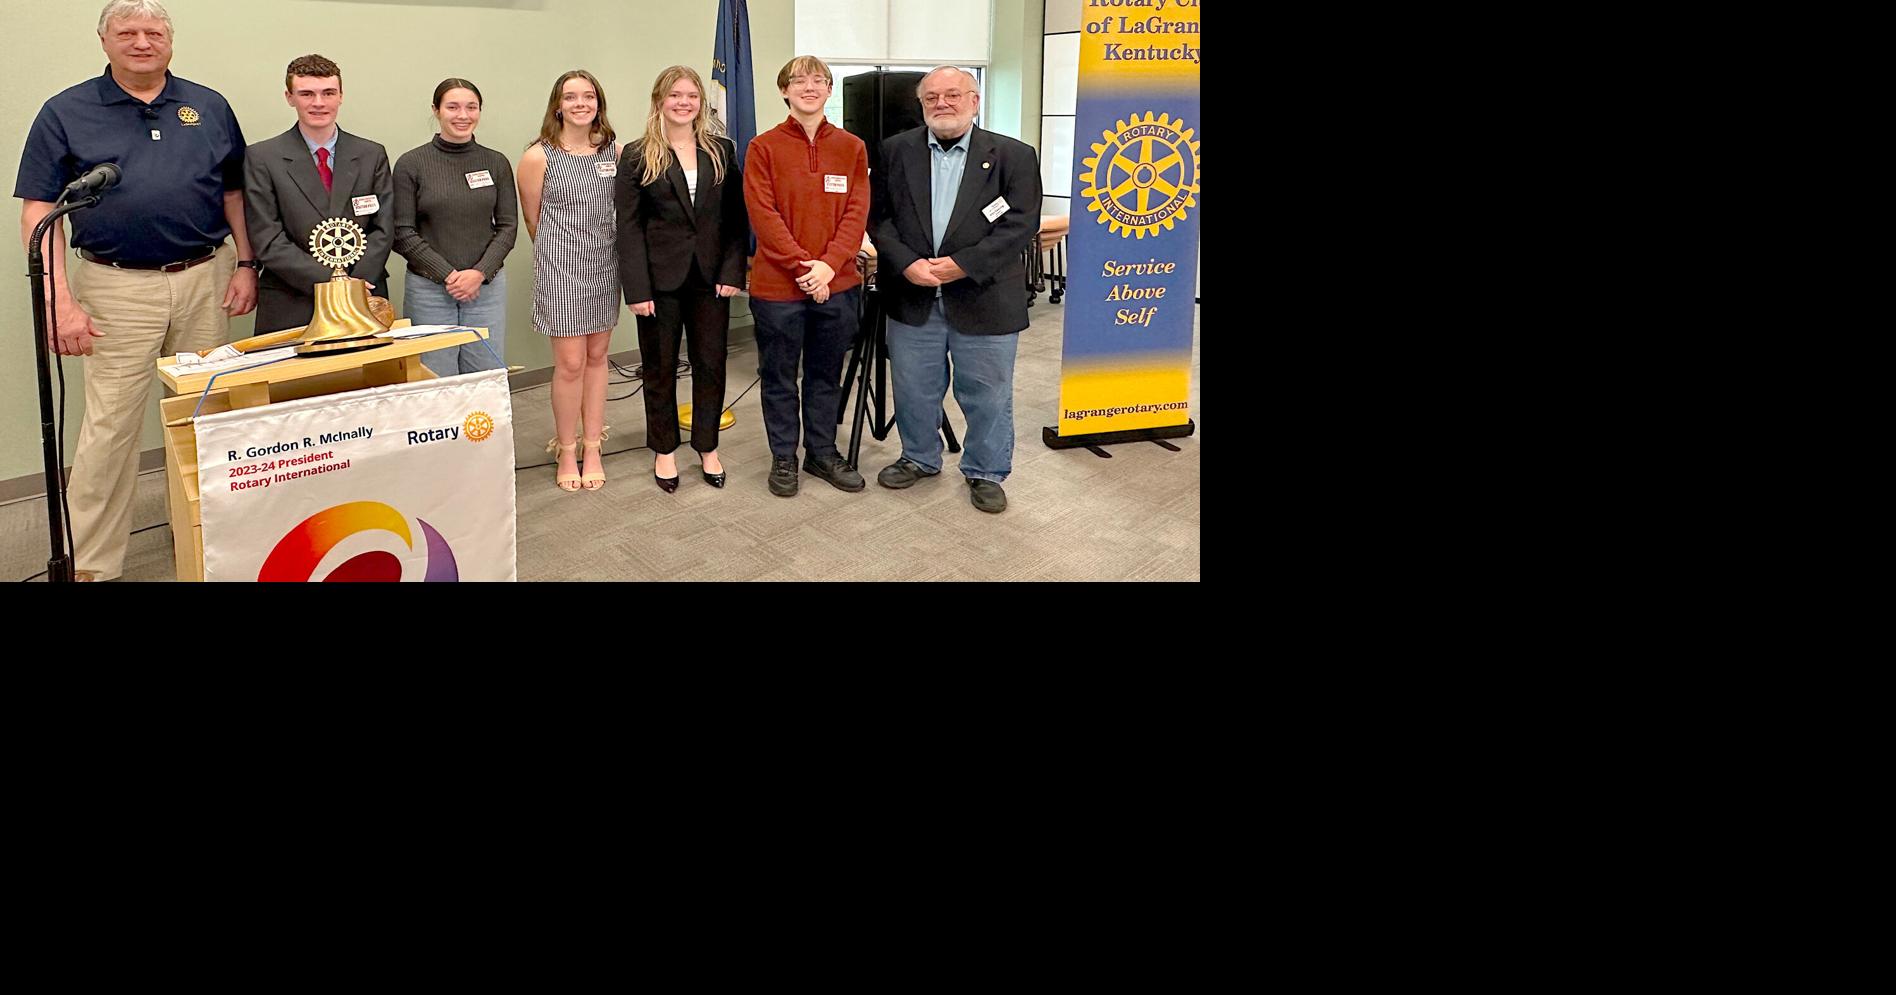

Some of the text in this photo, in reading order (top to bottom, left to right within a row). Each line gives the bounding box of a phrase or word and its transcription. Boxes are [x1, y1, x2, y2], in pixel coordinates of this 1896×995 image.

[1086, 16, 1200, 34] of LaGran
[1123, 125, 1175, 142] ROTARY
[1102, 193, 1188, 226] INTERNATIONAL
[1102, 258, 1176, 278] Service
[1105, 284, 1167, 302] Above
[1115, 307, 1158, 327] Self
[1064, 401, 1189, 420] lagrangerotary.com
[228, 426, 374, 461] R. Gordon R. McInally
[407, 424, 460, 445] Rotary
[229, 450, 334, 478] 2023-24 President
[230, 459, 351, 492] Rotary International
